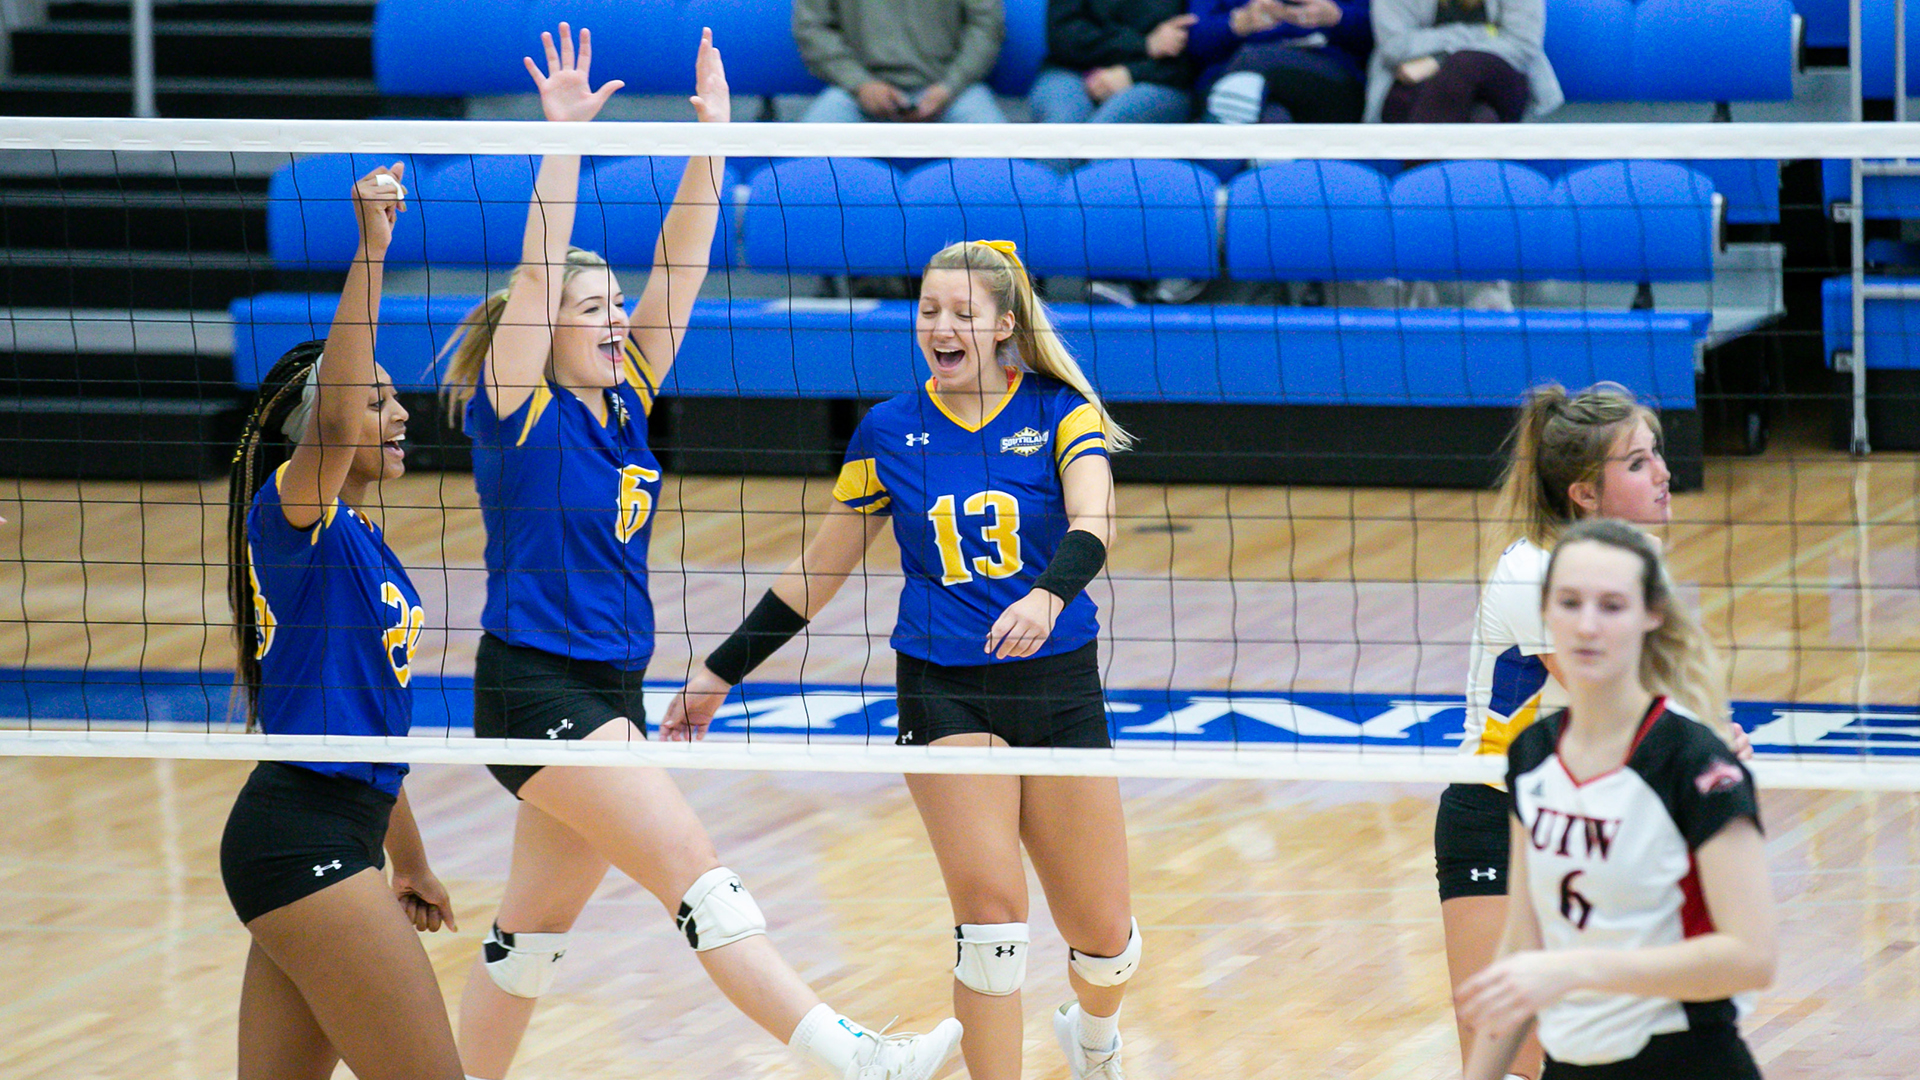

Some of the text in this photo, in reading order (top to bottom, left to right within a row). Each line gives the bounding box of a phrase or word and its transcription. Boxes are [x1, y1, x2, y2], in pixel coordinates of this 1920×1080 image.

[615, 463, 660, 544] 6
[927, 490, 1025, 587] 13
[1531, 806, 1622, 862] UIW
[1559, 868, 1595, 931] 6
